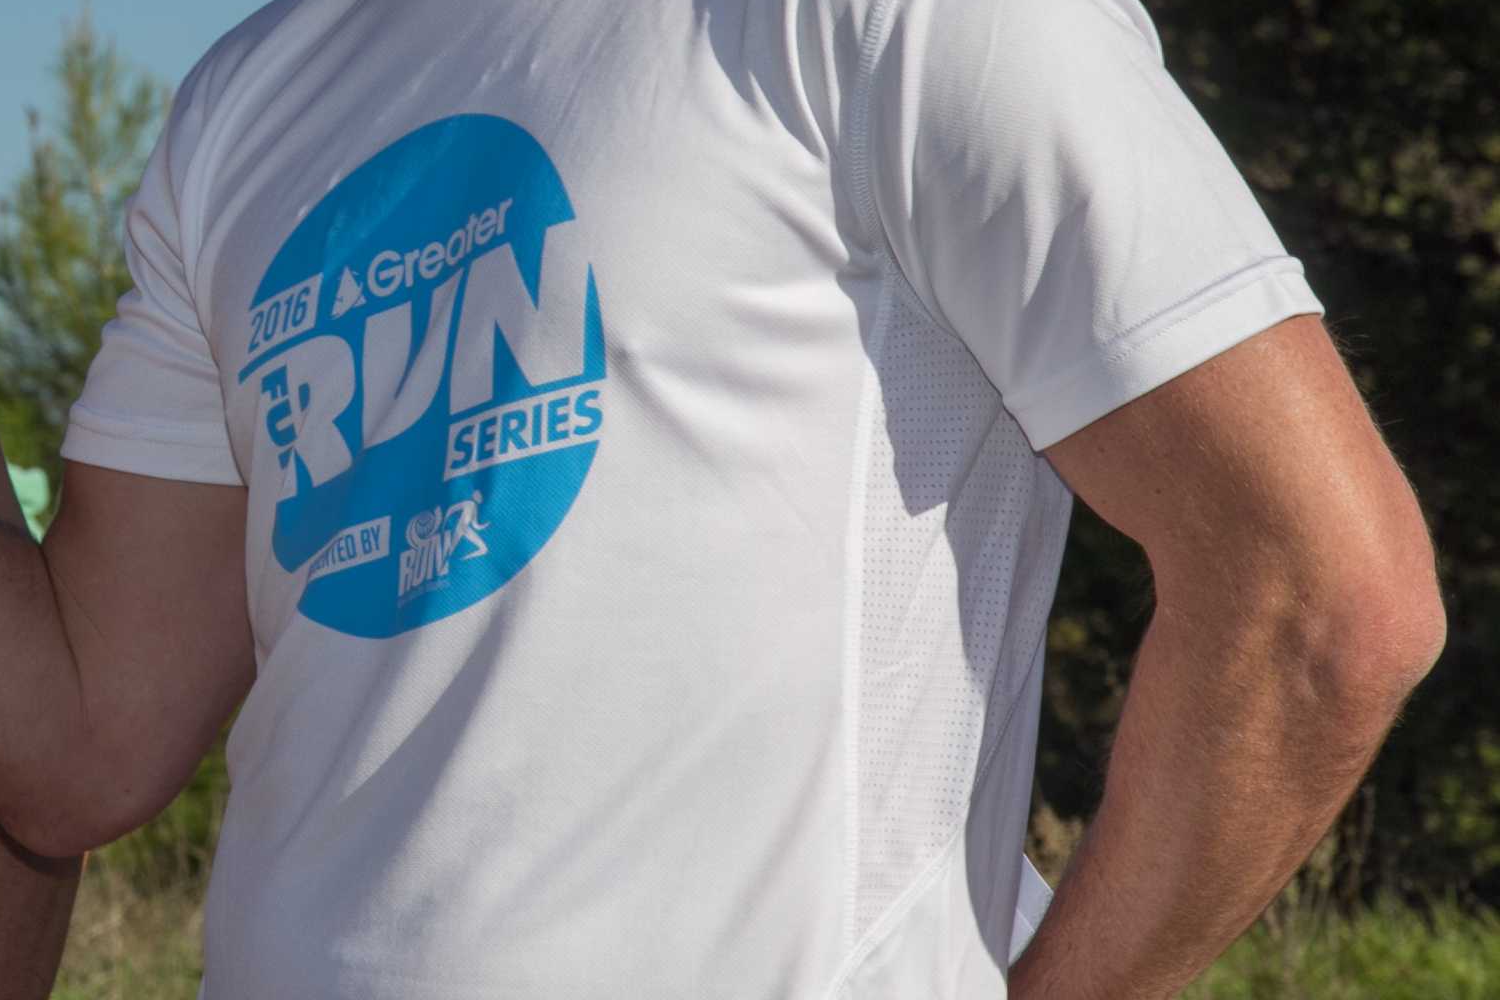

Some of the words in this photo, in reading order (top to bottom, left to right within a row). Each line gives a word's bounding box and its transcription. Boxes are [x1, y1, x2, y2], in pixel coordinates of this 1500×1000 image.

[248, 288, 310, 352] 2016
[366, 198, 514, 298] Greater
[245, 216, 594, 502] RUN
[447, 388, 604, 470] SERIES
[360, 524, 382, 555] BY
